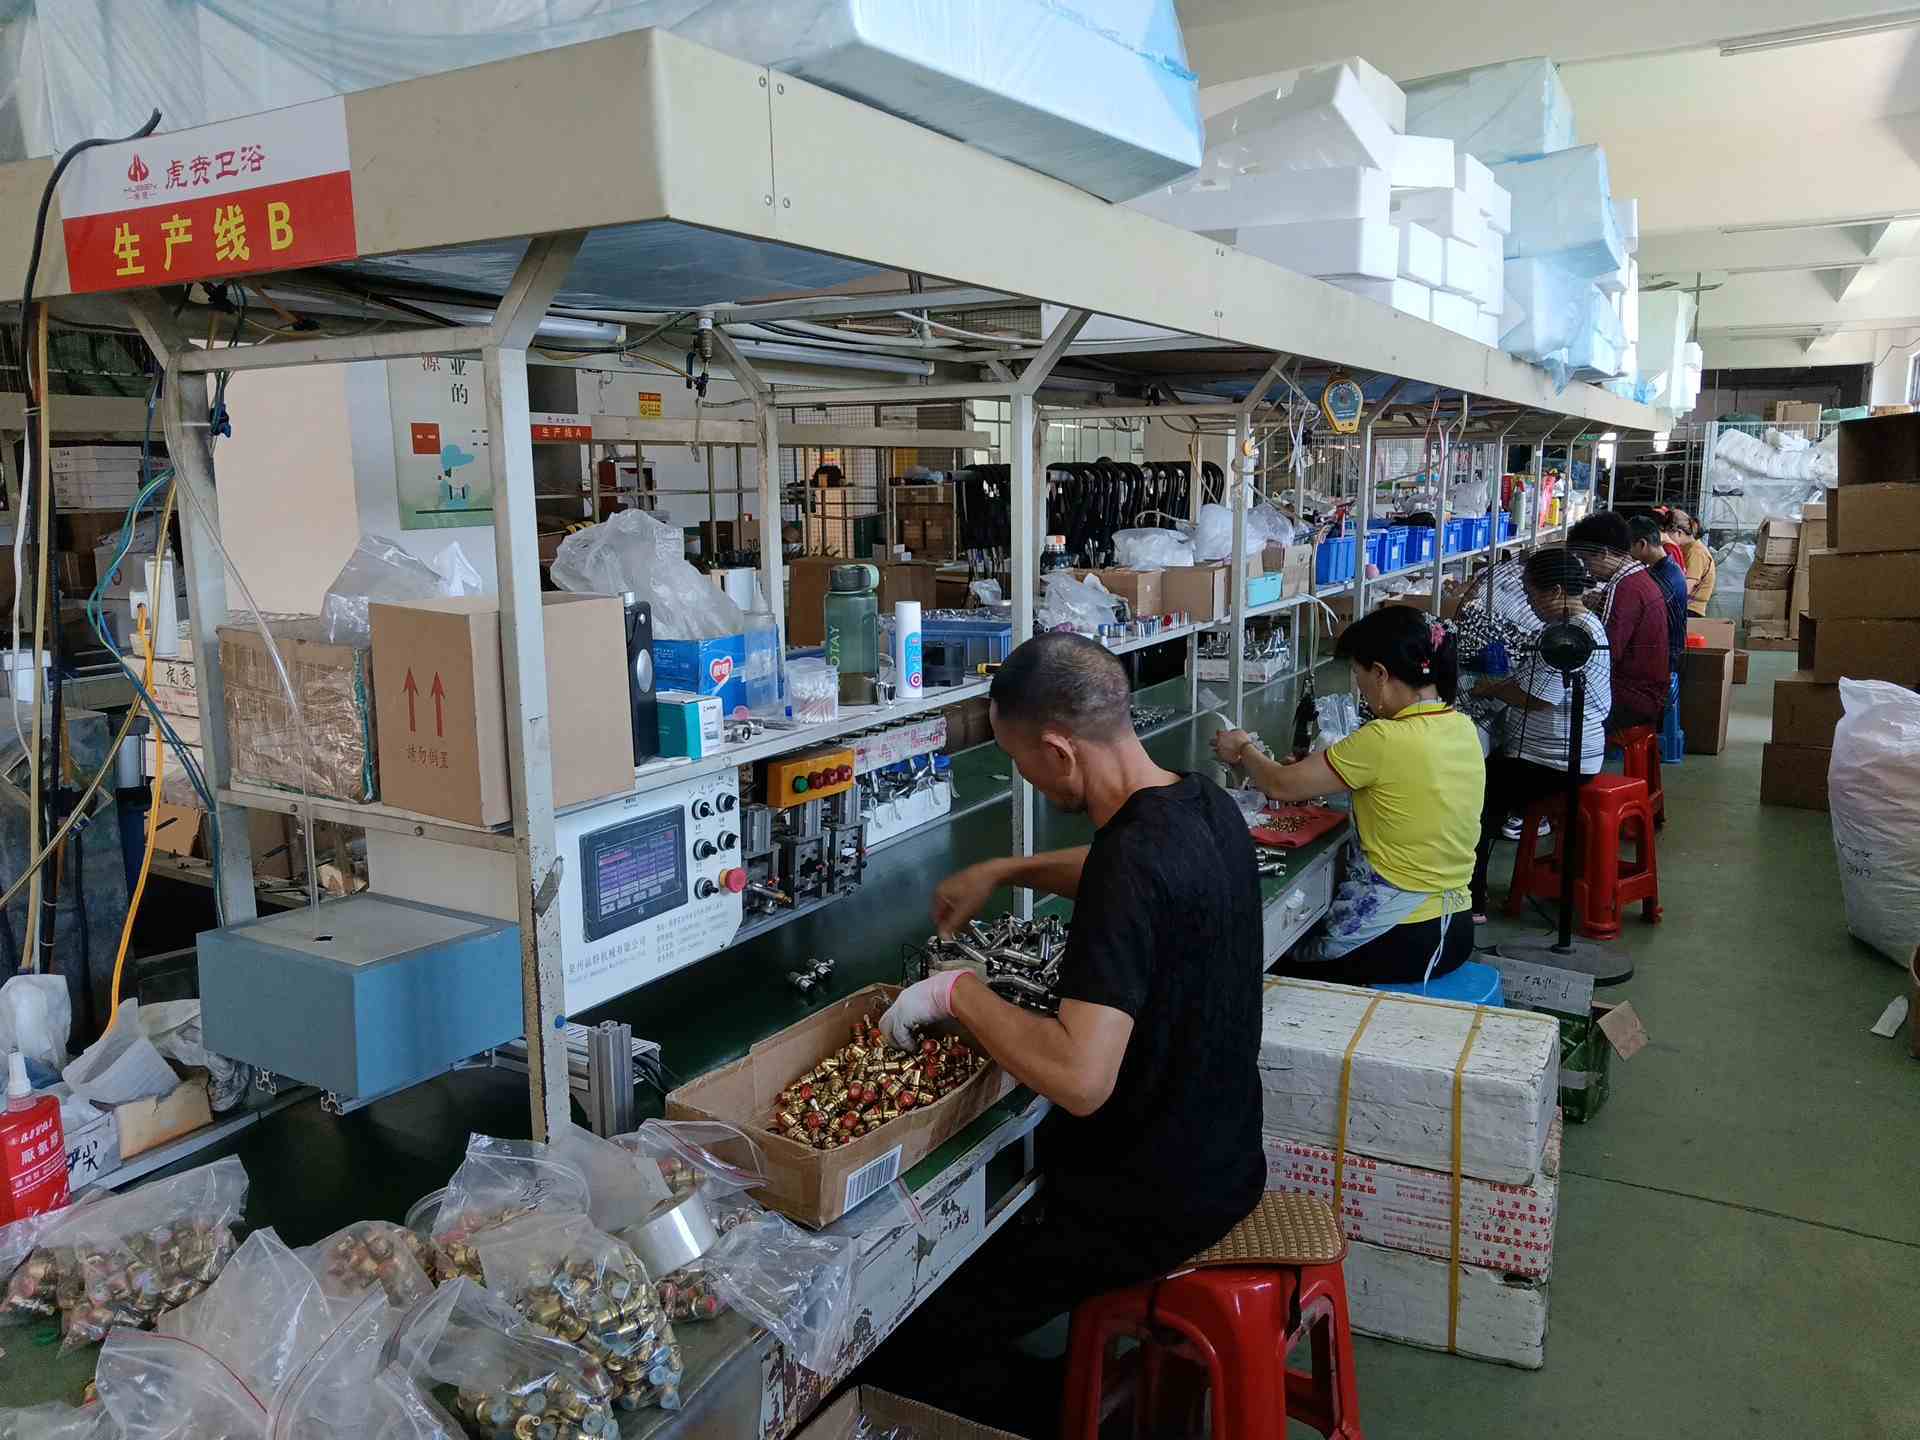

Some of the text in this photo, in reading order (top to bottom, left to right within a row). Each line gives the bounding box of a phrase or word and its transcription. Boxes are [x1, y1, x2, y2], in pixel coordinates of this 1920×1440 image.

[165, 144, 265, 190] 虎贲卫浴
[112, 201, 295, 276] 生产线B
